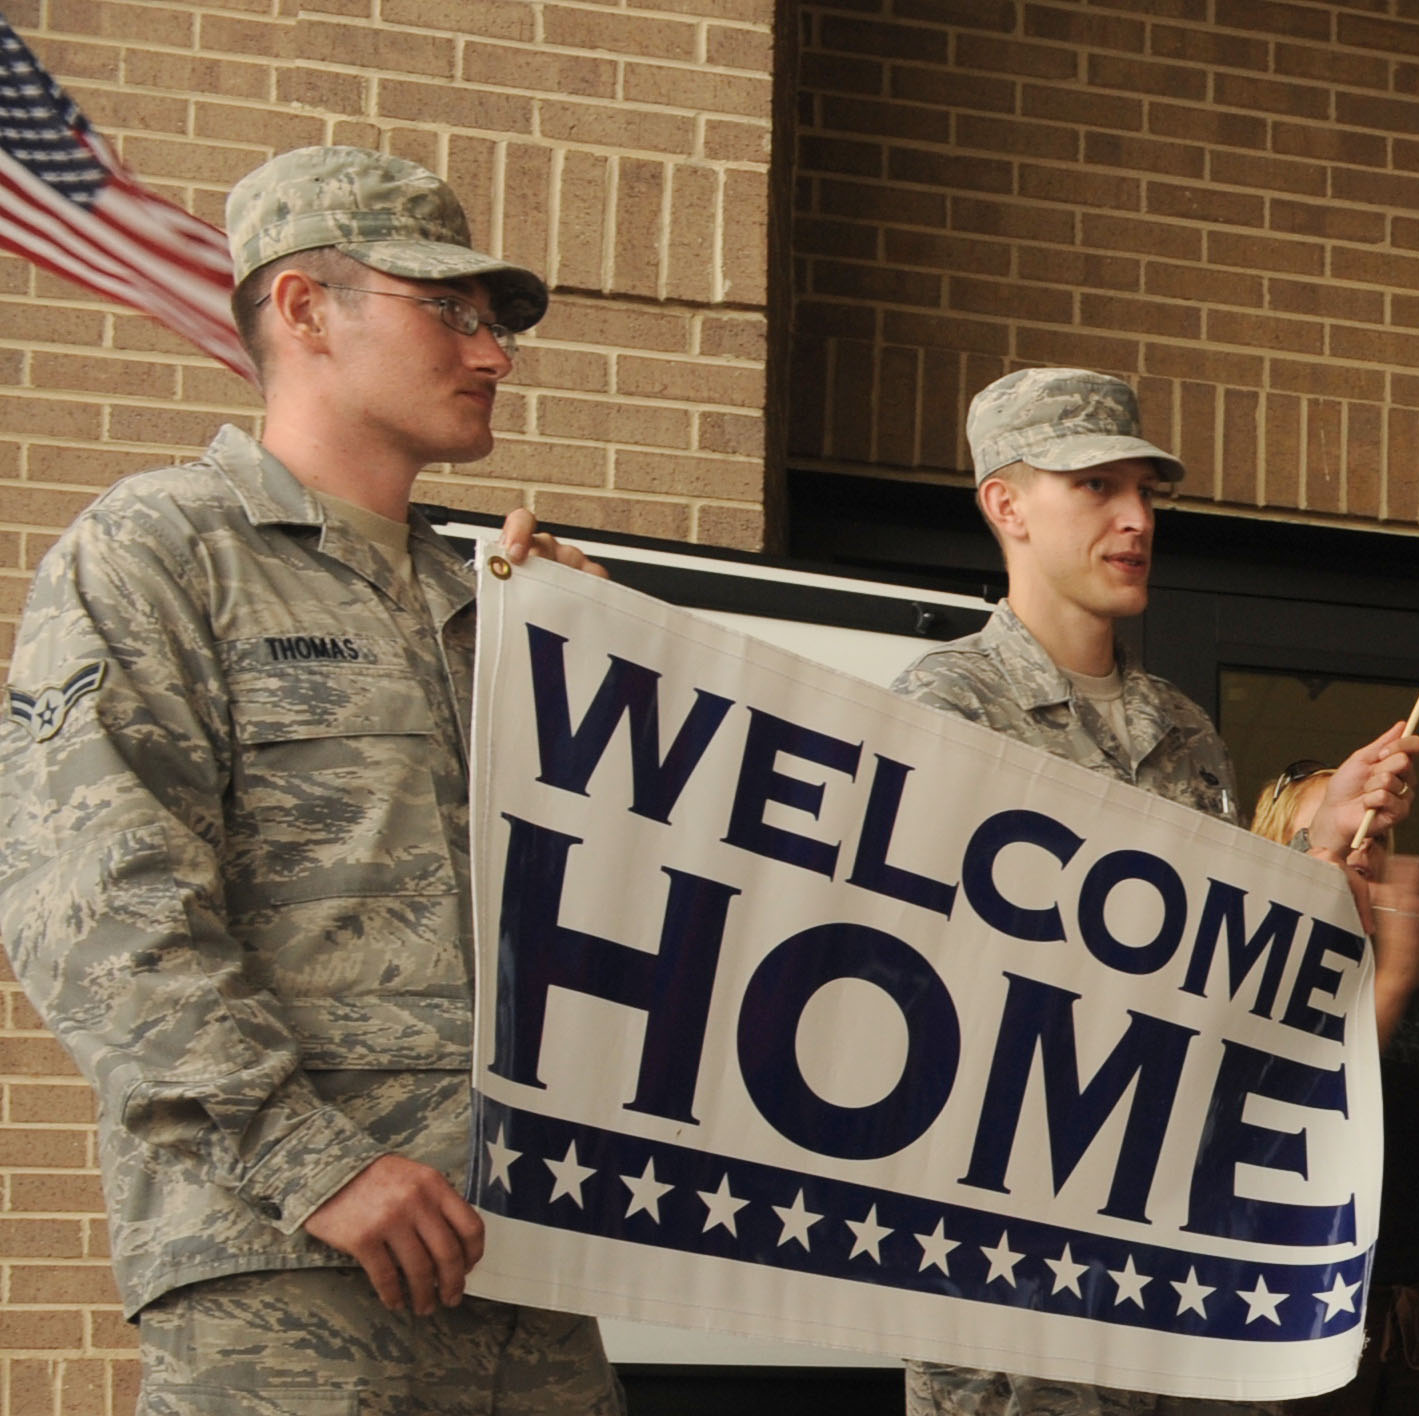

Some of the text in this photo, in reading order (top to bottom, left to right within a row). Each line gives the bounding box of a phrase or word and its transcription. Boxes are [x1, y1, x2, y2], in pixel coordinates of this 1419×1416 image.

[263, 635, 359, 661] THOMAS
[525, 622, 1365, 1046] WELCOME
[487, 812, 1358, 1248] HOME
